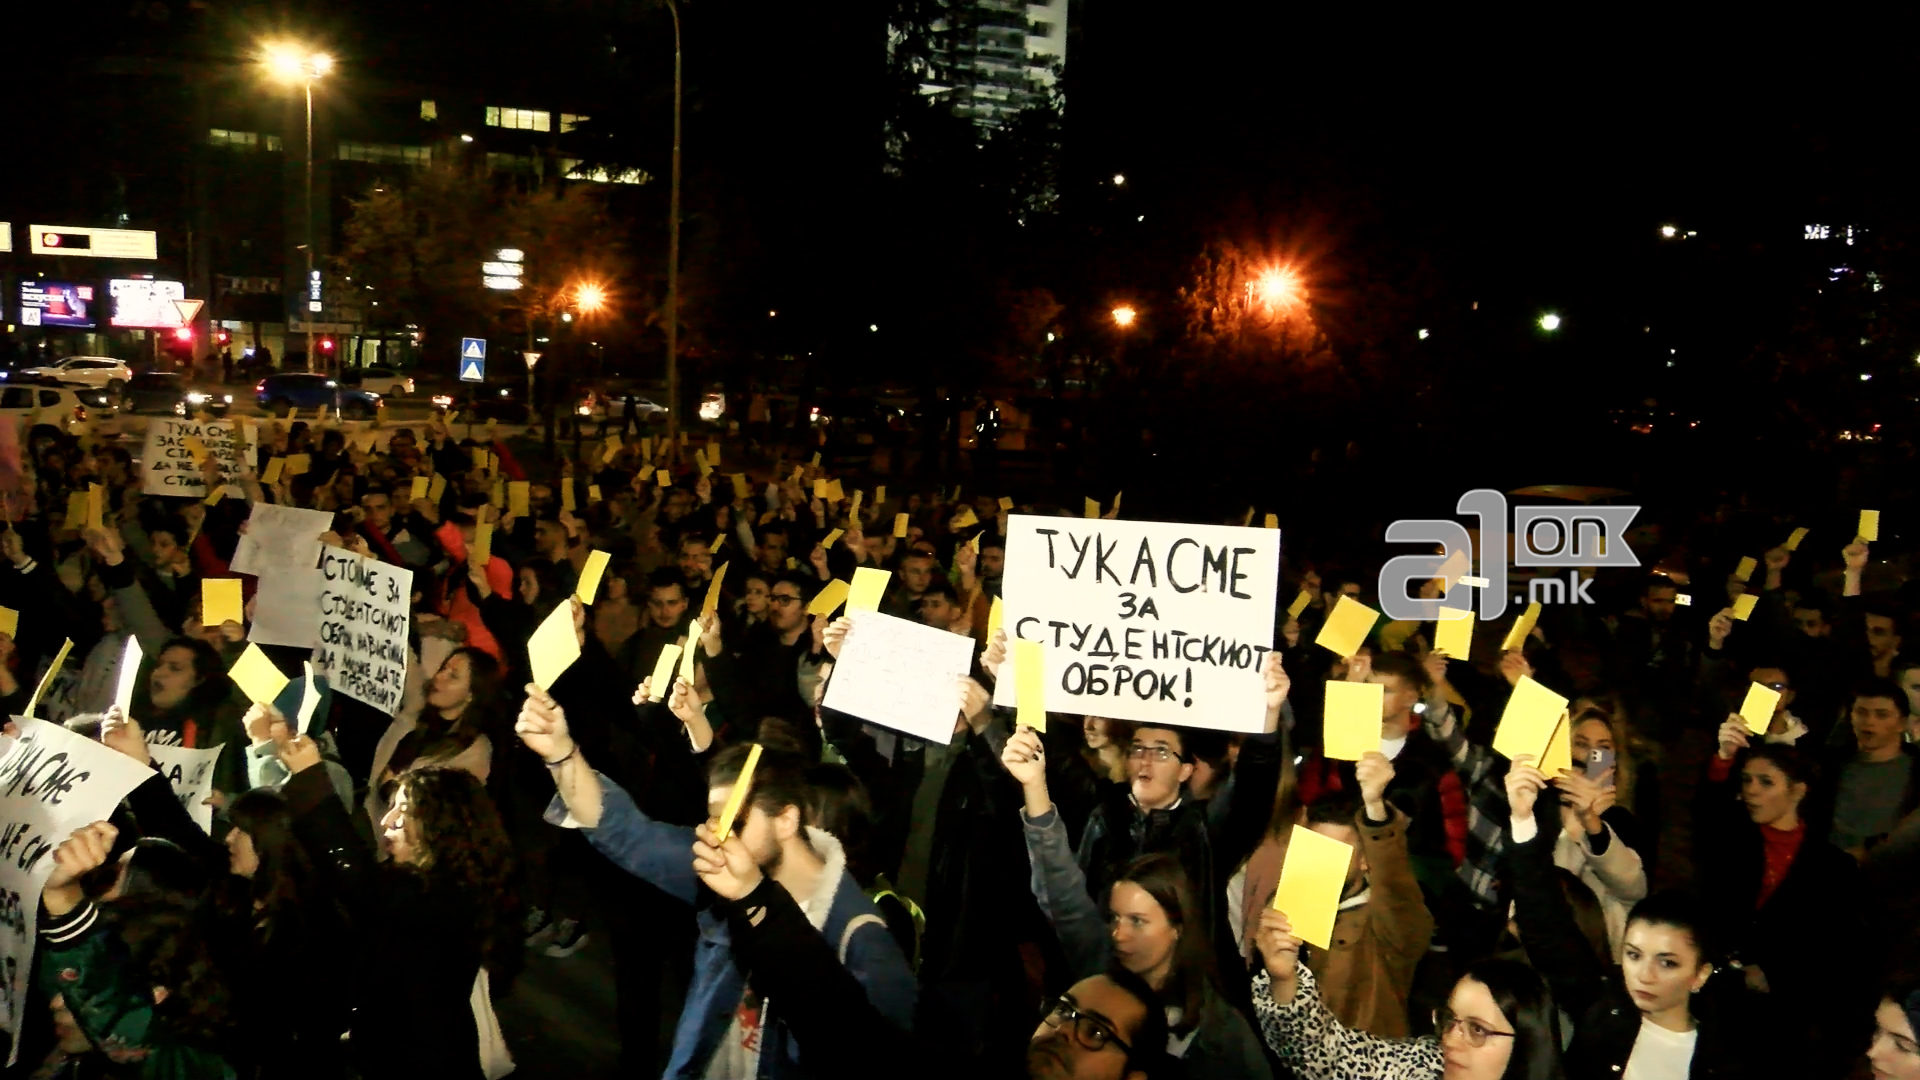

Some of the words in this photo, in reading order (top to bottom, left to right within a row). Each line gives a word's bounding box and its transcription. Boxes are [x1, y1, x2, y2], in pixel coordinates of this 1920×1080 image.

[1036, 528, 1158, 588] ТУКА
[1166, 537, 1257, 600] СМЕ
[1118, 592, 1160, 621] ЗА
[1016, 616, 1272, 673] СТУДЕНТСКИОТ
[1061, 662, 1193, 708] ОБРОК!
